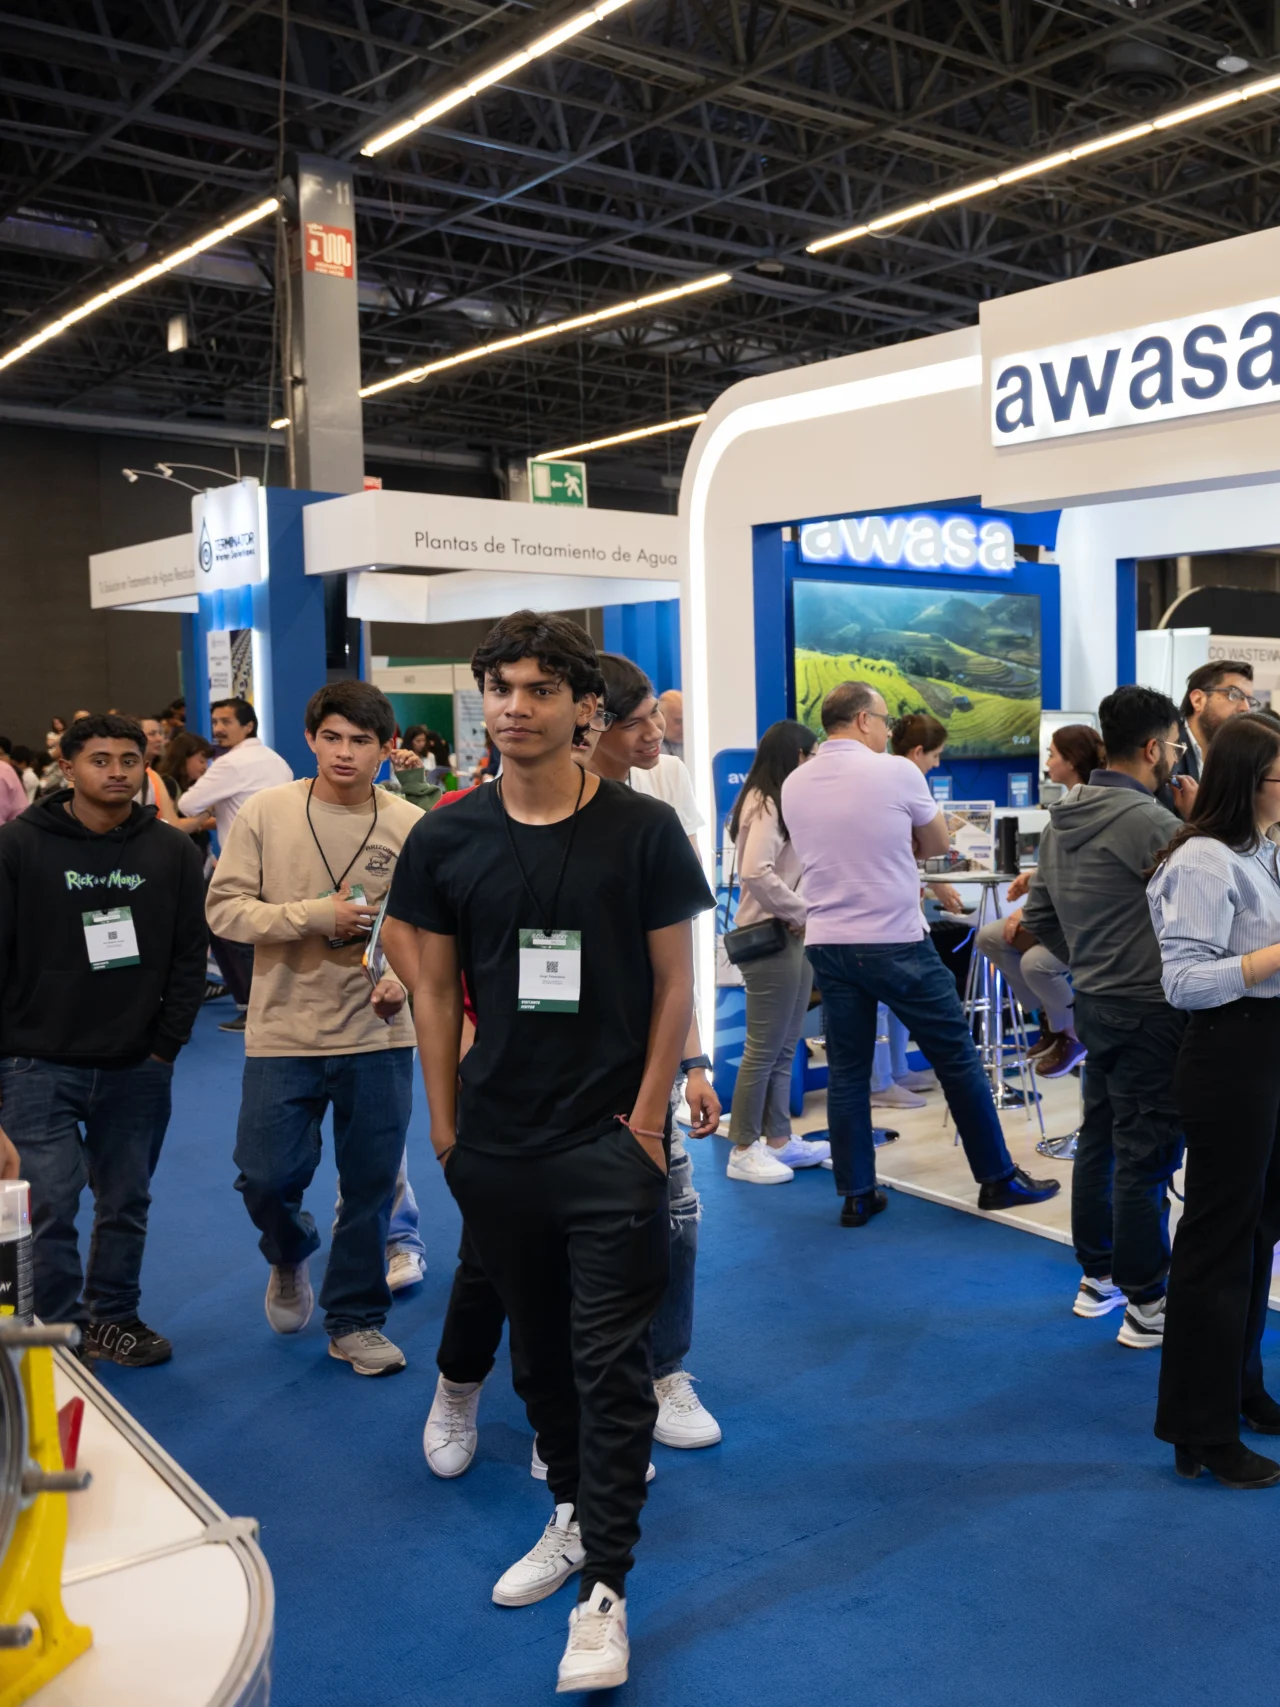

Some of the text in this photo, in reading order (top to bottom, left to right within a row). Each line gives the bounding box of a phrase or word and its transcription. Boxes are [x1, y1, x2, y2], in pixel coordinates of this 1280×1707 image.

[414, 531, 678, 568] Plantas de Tratamiento de Agua
[803, 516, 1015, 570] awasa
